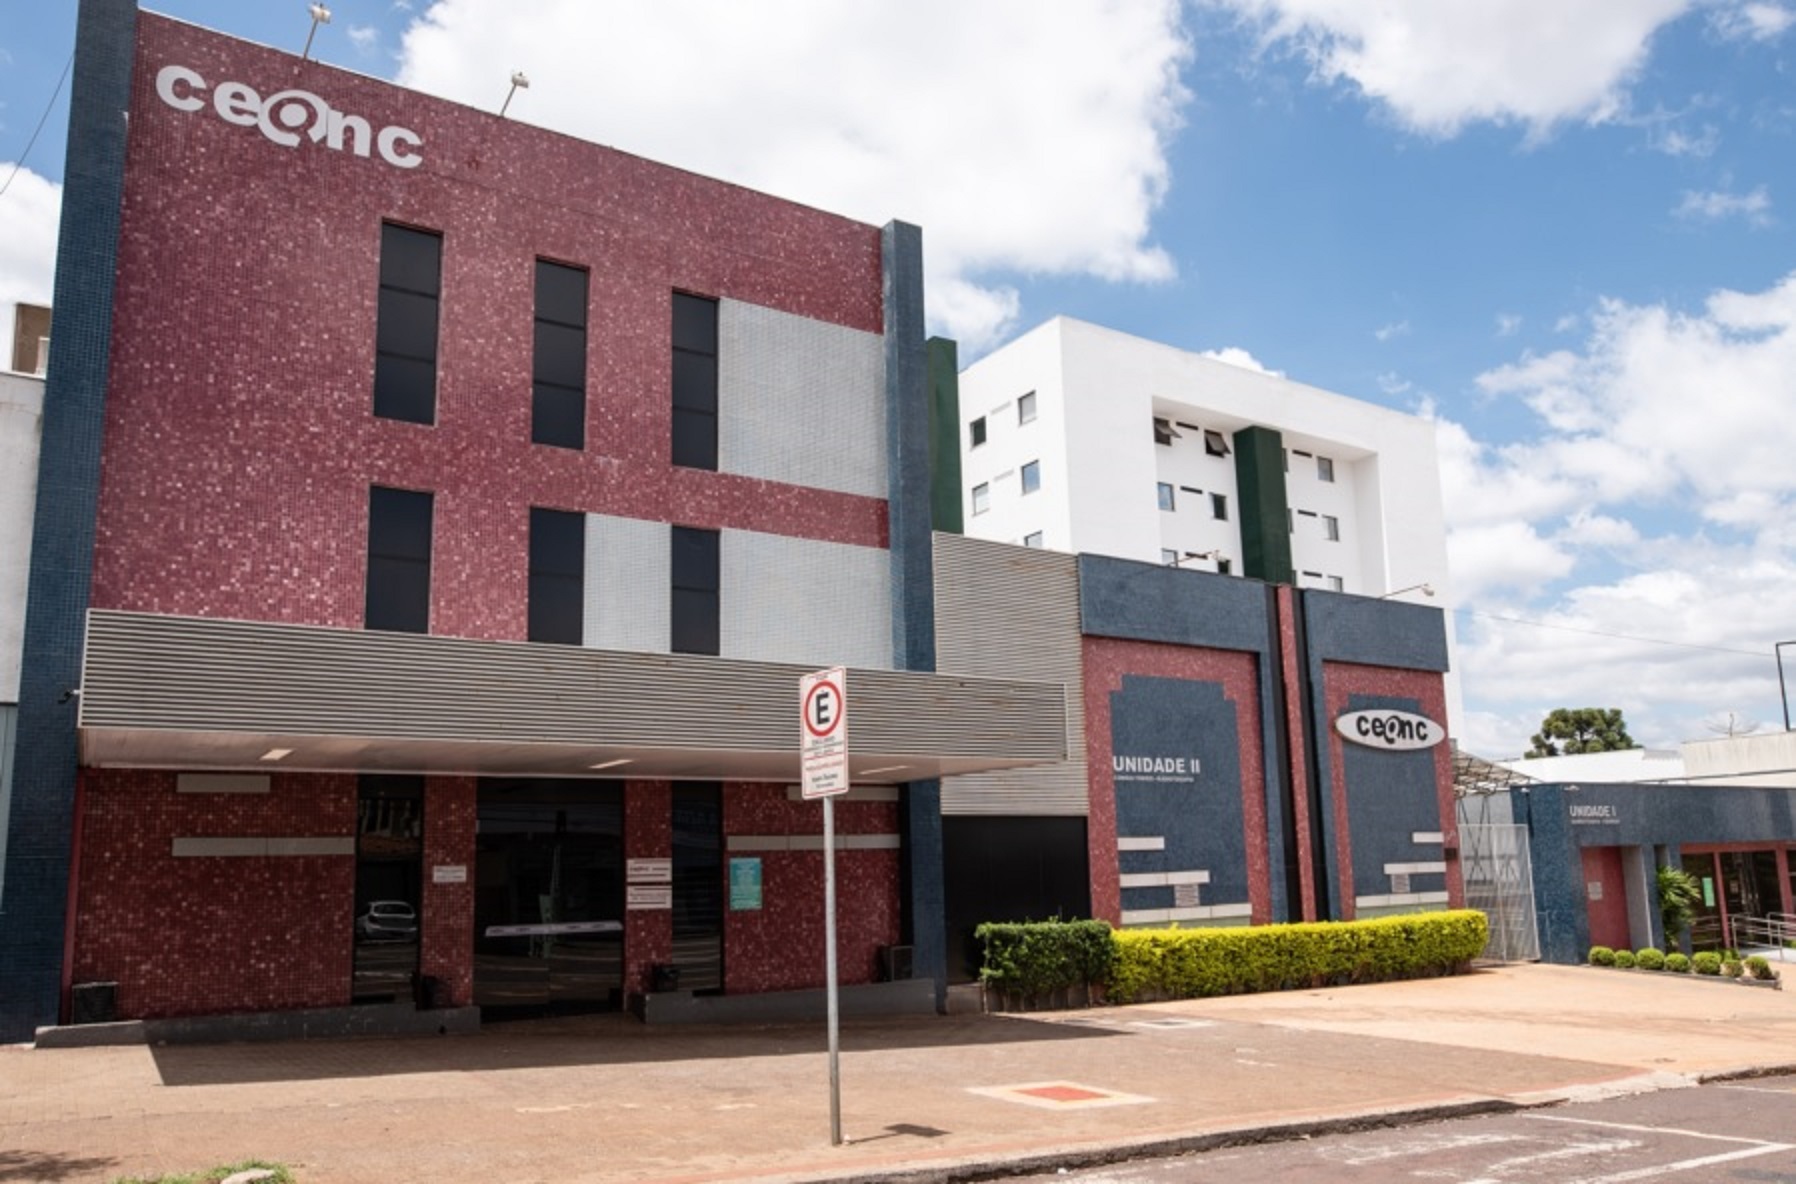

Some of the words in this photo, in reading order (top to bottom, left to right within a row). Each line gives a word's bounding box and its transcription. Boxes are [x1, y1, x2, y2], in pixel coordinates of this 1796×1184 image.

[155, 65, 424, 169] ceonc
[815, 691, 831, 725] E
[1355, 715, 1429, 745] ceonc
[1112, 756, 1186, 773] UNIDADE
[1190, 758, 1201, 774] II
[1569, 804, 1611, 817] UNIDADE
